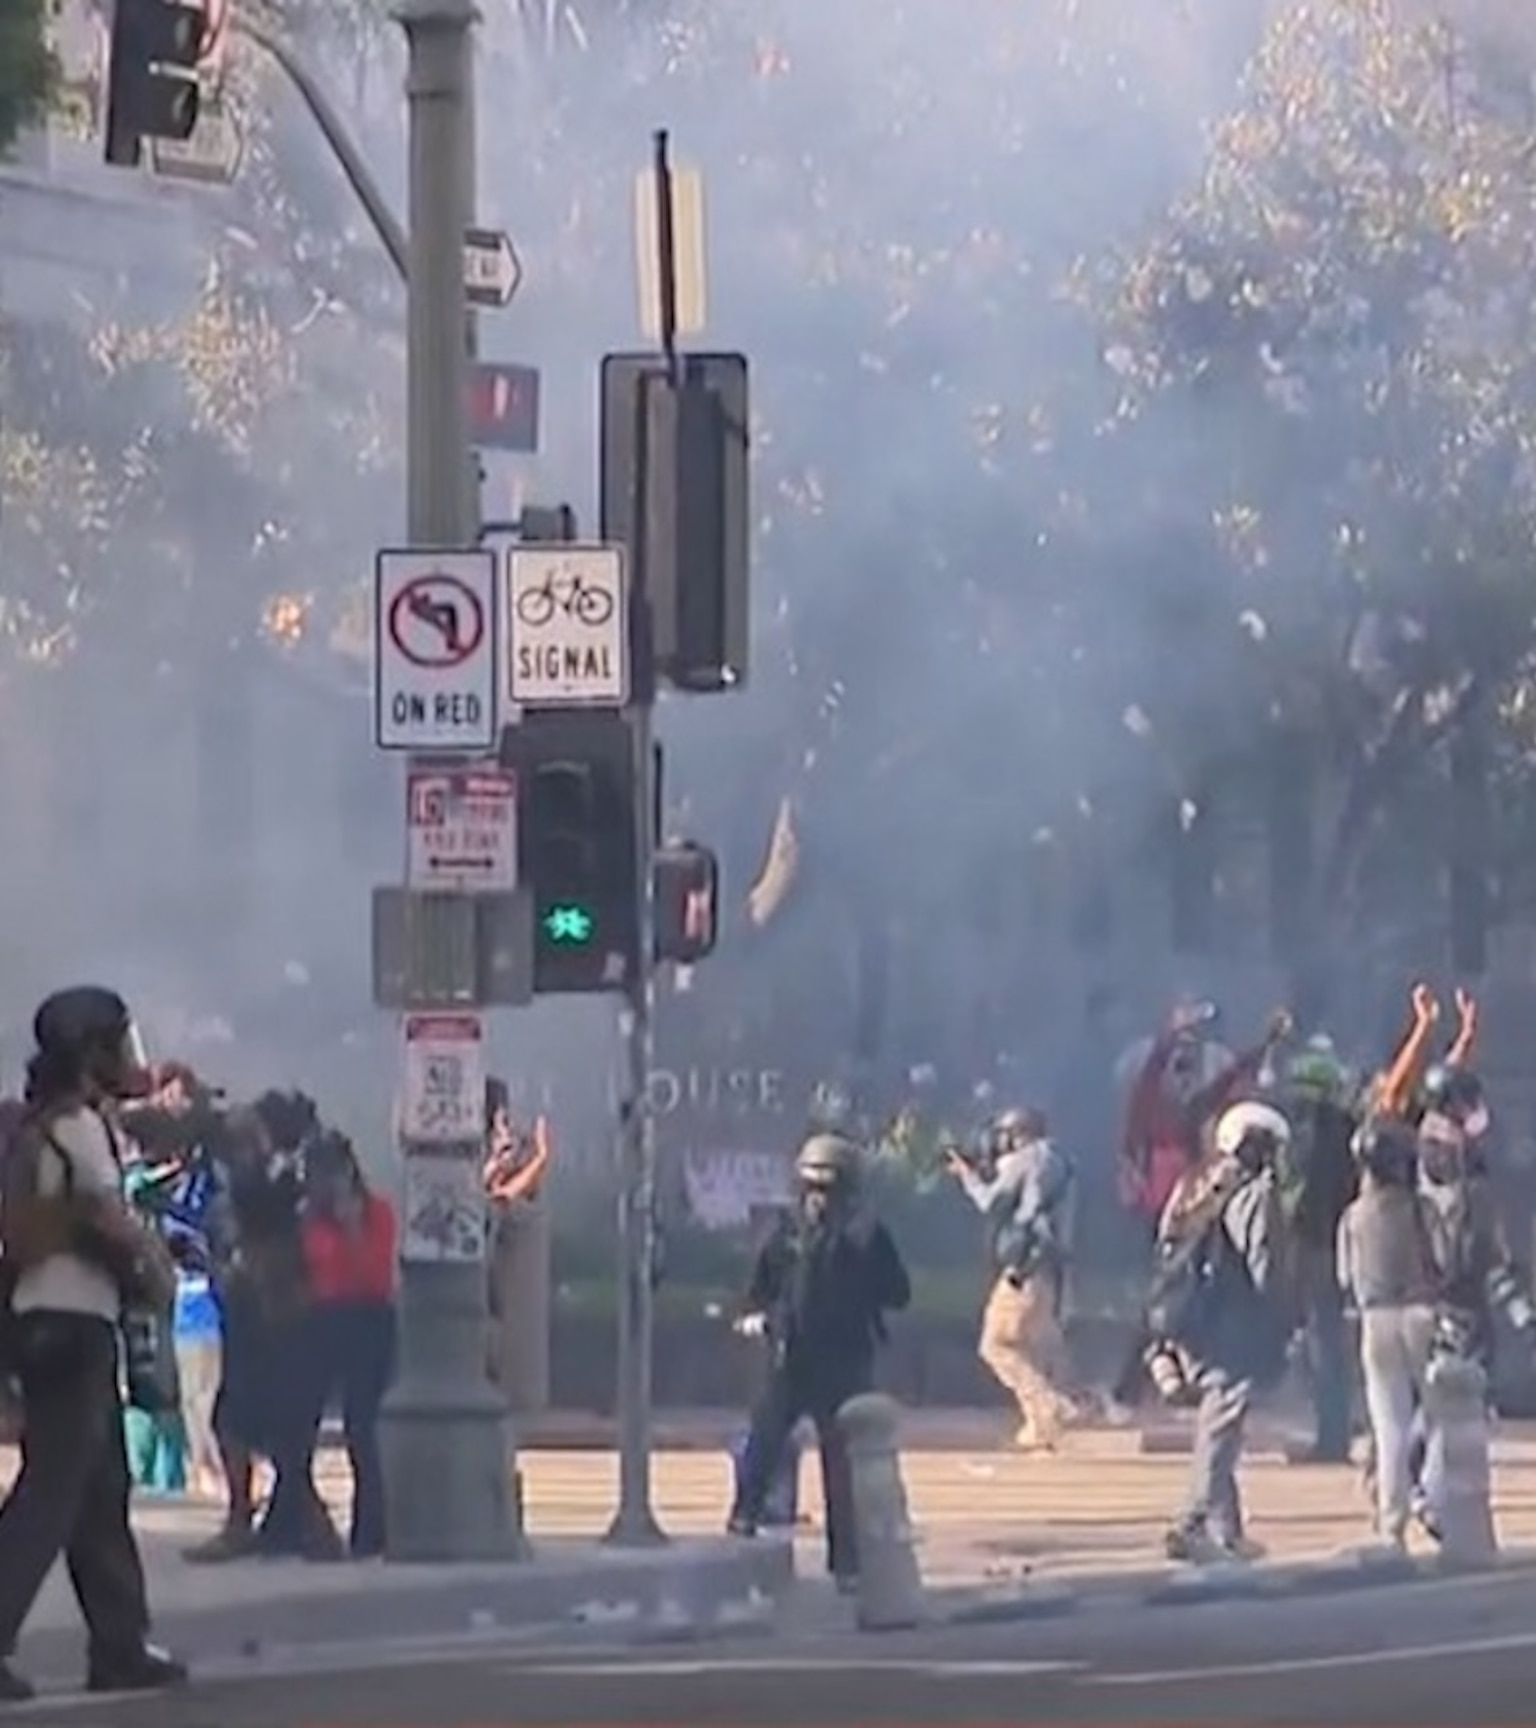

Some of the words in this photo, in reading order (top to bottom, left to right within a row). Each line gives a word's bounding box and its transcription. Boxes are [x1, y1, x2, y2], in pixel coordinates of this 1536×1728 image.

[518, 646, 612, 680] SIGNAL
[393, 693, 425, 725] ON
[435, 694, 480, 724] RED
